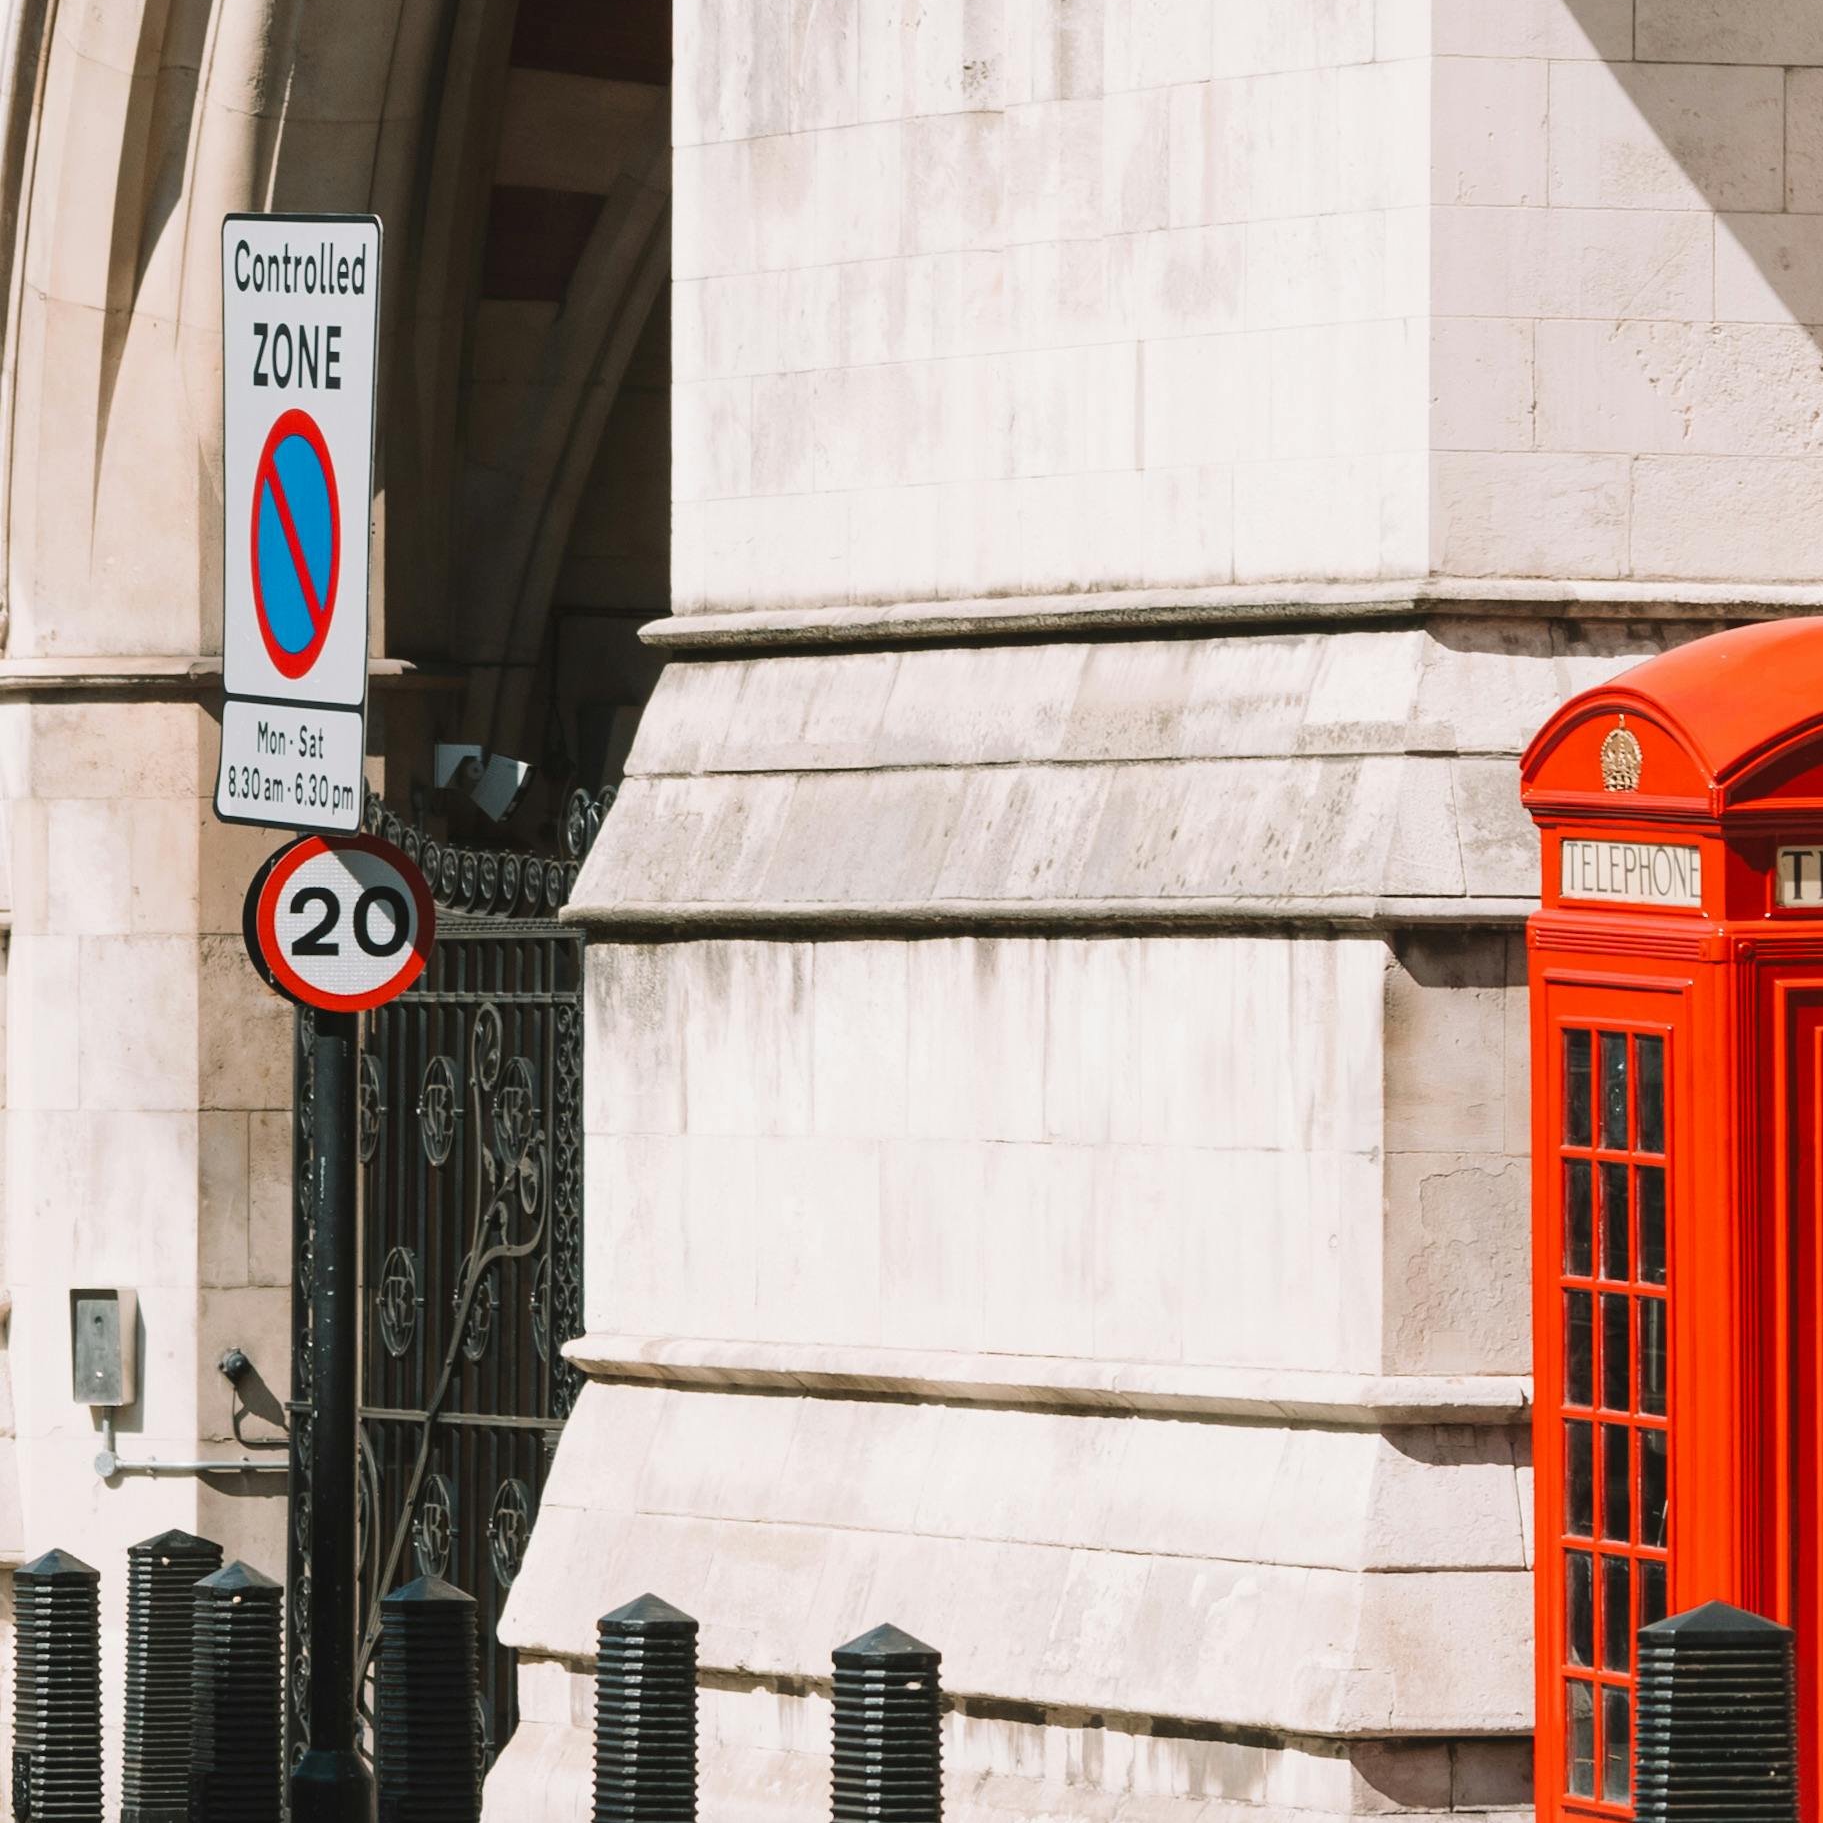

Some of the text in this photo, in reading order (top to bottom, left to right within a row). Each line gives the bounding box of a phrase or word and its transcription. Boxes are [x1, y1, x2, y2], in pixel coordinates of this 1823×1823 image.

[234, 239, 366, 295] Controlled
[253, 322, 342, 389] ZONE
[257, 721, 286, 756] Mon
[298, 725, 324, 759] Sat
[228, 765, 260, 800] 8.30
[264, 776, 284, 802] am
[295, 772, 328, 807] 6.30
[332, 783, 354, 815] pm
[1566, 843, 1701, 898] TELEPHONE
[289, 886, 410, 958] 20
